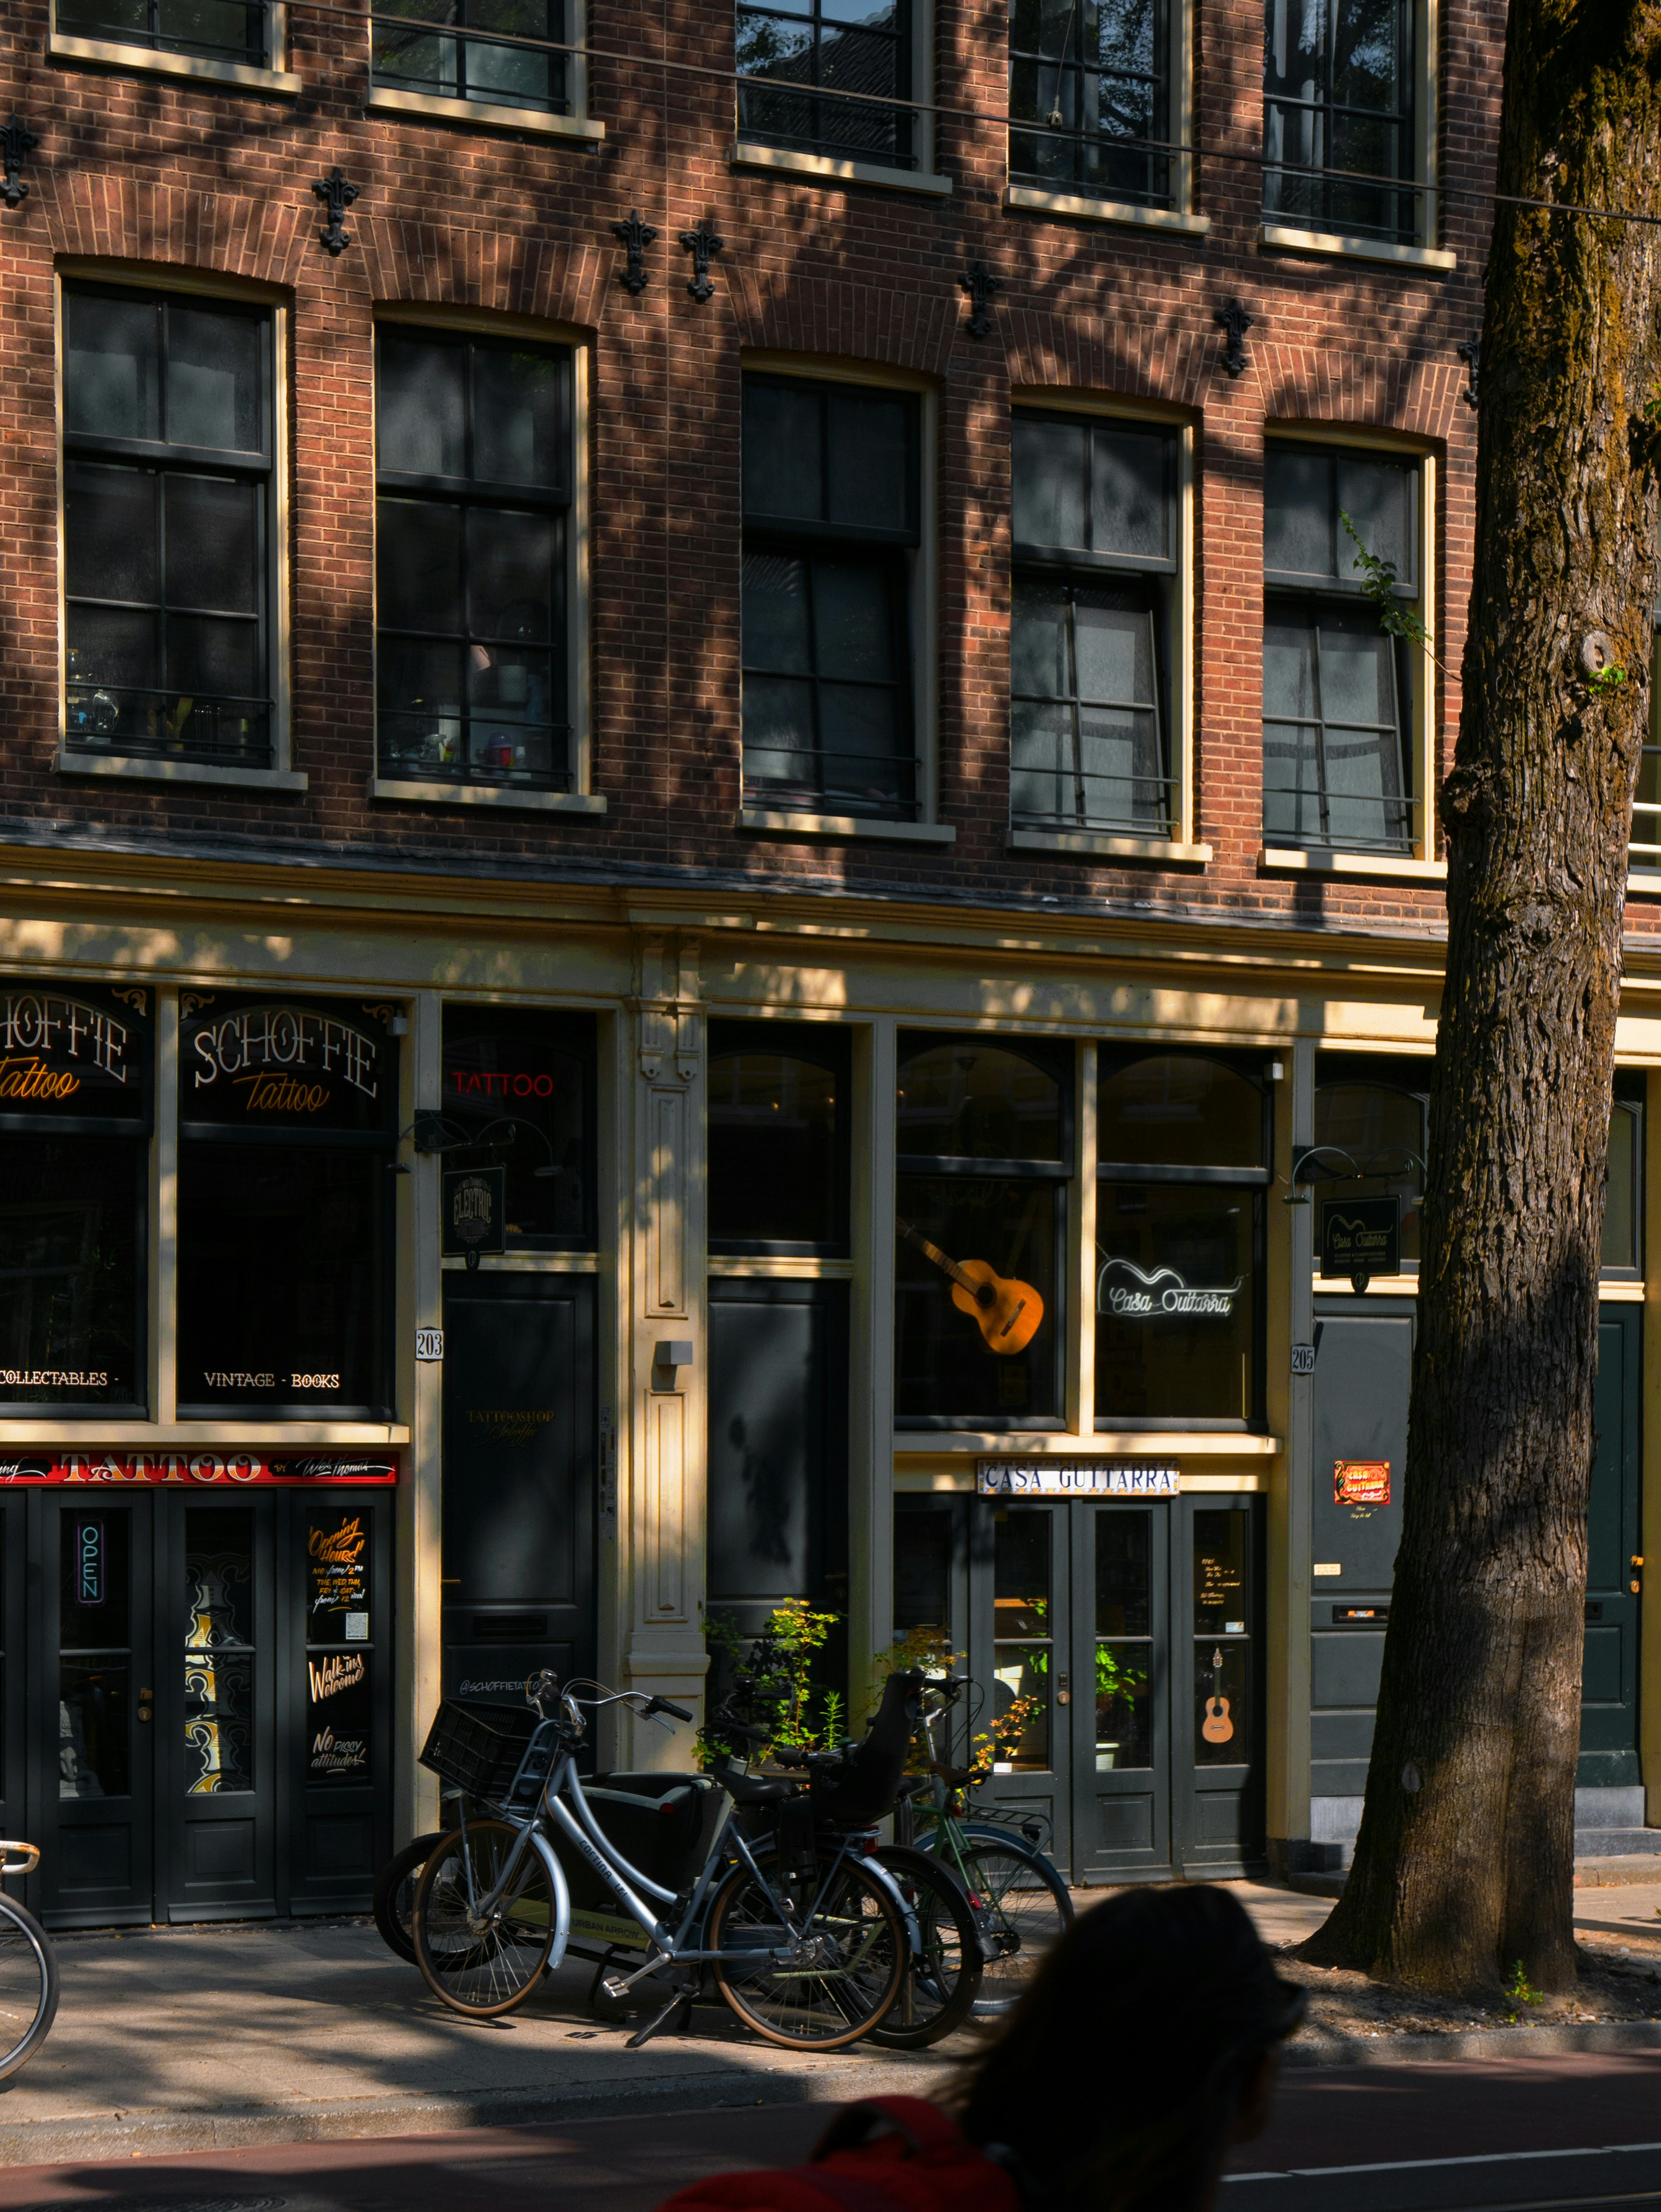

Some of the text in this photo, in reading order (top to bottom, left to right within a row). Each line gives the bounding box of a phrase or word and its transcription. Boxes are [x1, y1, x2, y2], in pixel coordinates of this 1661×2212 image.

[194, 1010, 377, 1098] SCHOFFIE
[232, 1070, 331, 1112] Tattoo
[451, 1071, 554, 1097] TATTOO
[454, 1188, 492, 1225] ELECTRIC
[1332, 1232, 1352, 1249] Casa
[1110, 1288, 1153, 1313] Casa
[417, 1333, 442, 1356] 203
[1293, 1349, 1314, 1370] 205
[0, 1370, 109, 1386] COLLECTABLES
[204, 1372, 275, 1387] VINTAGE
[290, 1373, 340, 1388] BOOKS
[464, 1410, 556, 1424] TATTOOSHOP
[61, 1454, 262, 1482] TATTOO
[985, 1466, 1170, 1488] CASA GUITARRA
[82, 1526, 98, 1598] OPEN
[333, 1741, 363, 1753] PISSY
[571, 1918, 640, 1939] URBAN ARROW
